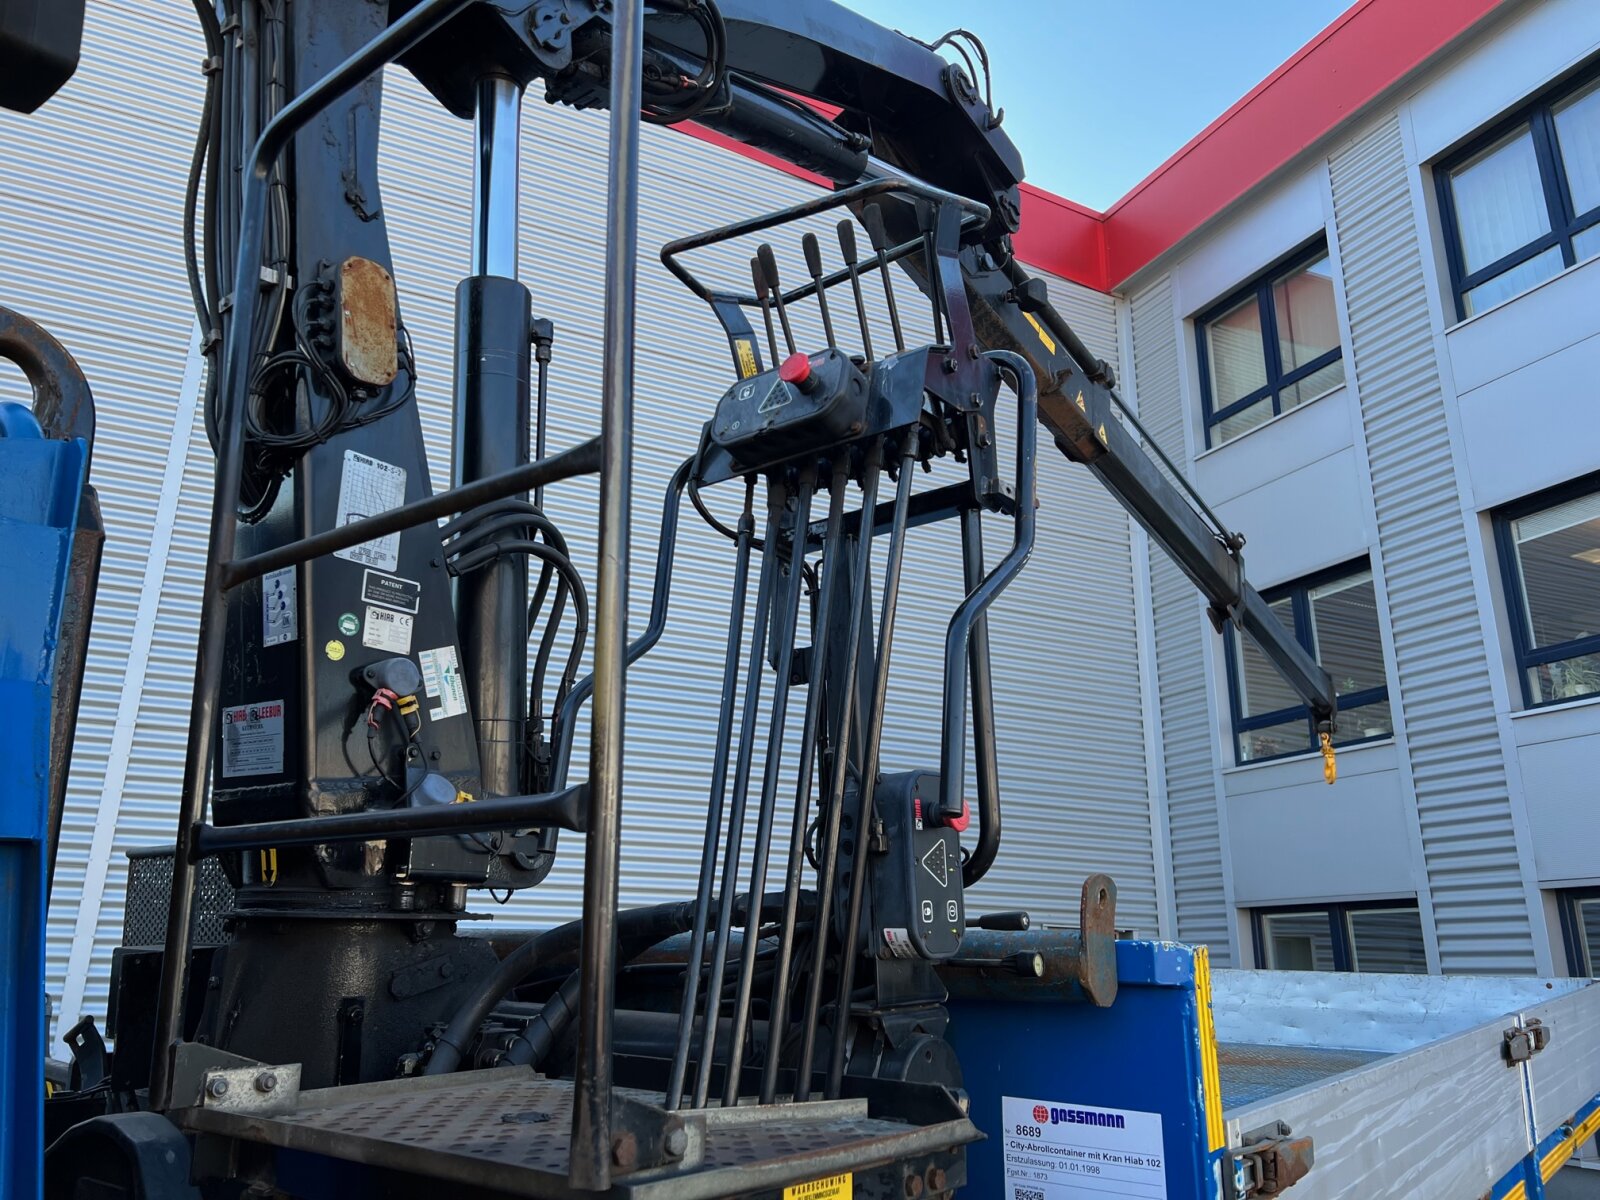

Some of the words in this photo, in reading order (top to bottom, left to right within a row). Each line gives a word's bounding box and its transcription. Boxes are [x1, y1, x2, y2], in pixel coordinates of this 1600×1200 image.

[380, 580, 404, 590] PATENT
[380, 612, 394, 622] HIAB
[449, 676, 458, 701] Rhenen
[233, 710, 247, 722] HIAB
[258, 705, 282, 720] LEEBUR
[1051, 1108, 1125, 1128] gassmann
[1016, 1125, 1042, 1138] 8689
[1010, 1141, 1086, 1158] City-Abrollcontainer
[1088, 1152, 1100, 1160] mit
[1102, 1153, 1122, 1162] Kran
[1124, 1157, 1144, 1166] Hiab
[1146, 1158, 1161, 1168] 102
[1059, 1162, 1100, 1174] 01.01.1998
[792, 1176, 846, 1196] WAARSCHUWING
